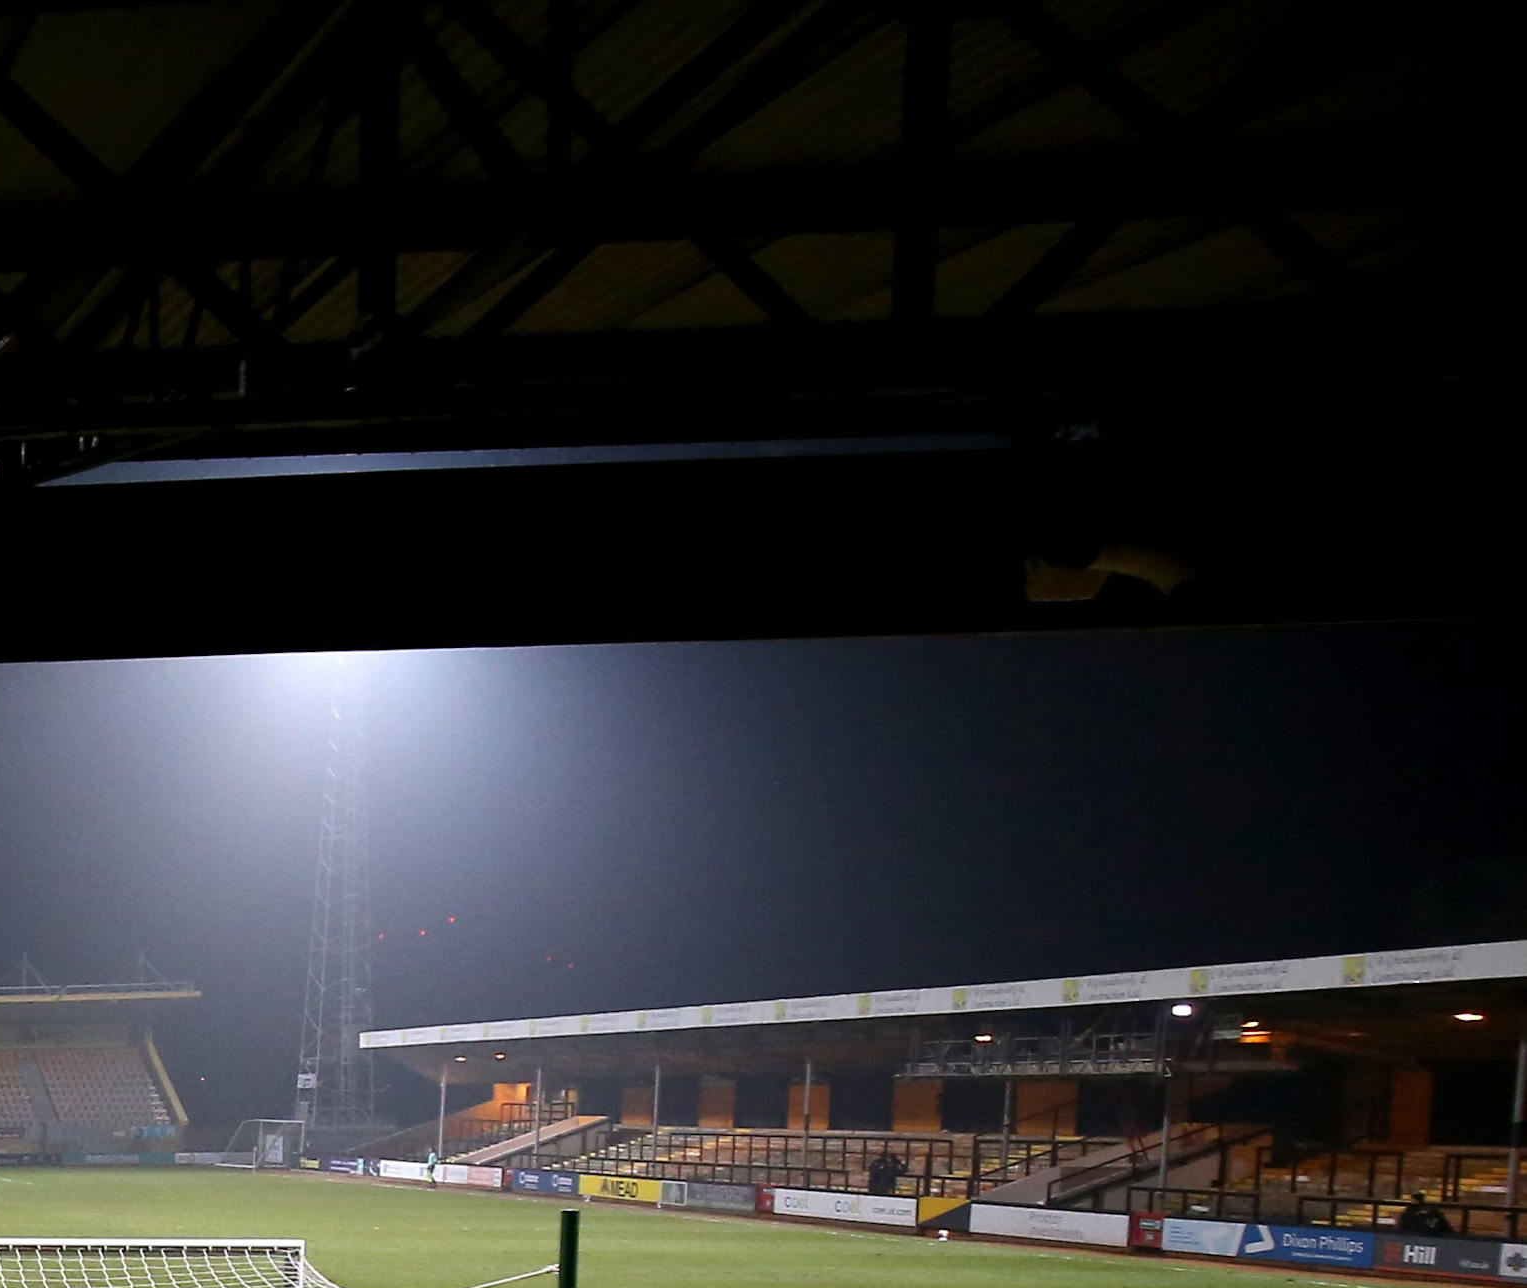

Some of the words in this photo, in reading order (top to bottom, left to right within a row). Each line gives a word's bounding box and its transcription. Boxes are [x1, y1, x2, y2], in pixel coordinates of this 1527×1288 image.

[611, 1179, 639, 1199] MEAD
[1283, 1233, 1316, 1249] Dixon
[1319, 1234, 1364, 1254] Phillips
[1403, 1243, 1437, 1266] Hill
